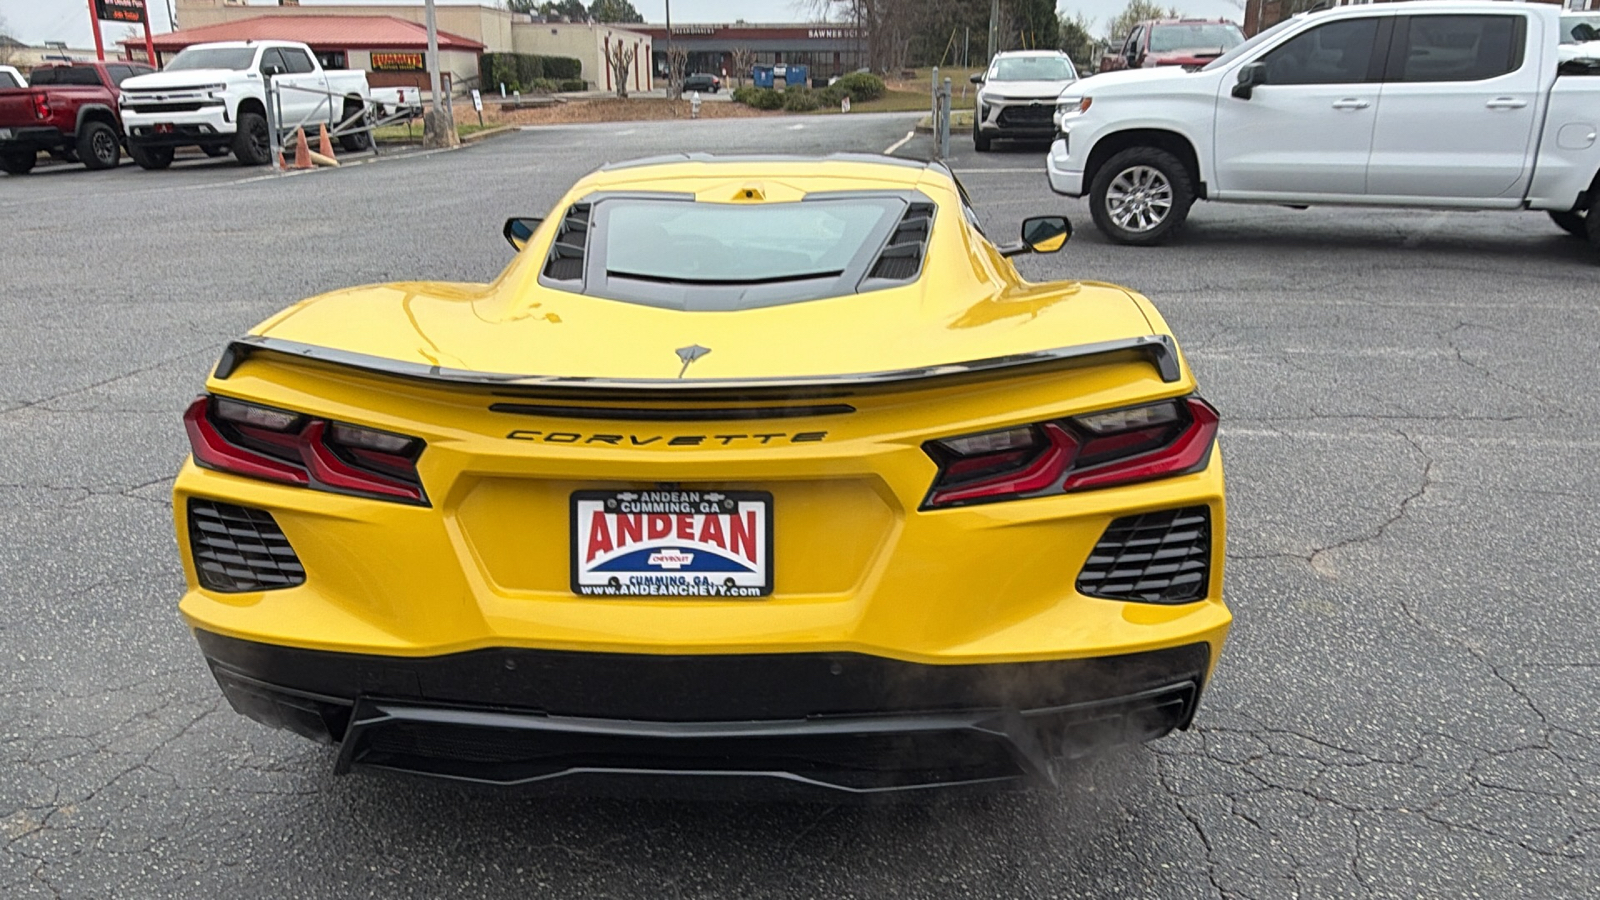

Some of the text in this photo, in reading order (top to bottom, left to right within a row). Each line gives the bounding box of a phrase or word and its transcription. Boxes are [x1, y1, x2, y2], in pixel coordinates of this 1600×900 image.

[506, 429, 828, 446] CORVETTE
[641, 491, 700, 503] ANDEAN
[620, 502, 720, 513] CUMMING, GA
[586, 510, 757, 566] ANDEAN
[652, 555, 690, 563] CHEVROLET
[580, 585, 761, 596] www.ANDEANCHEVY.com
